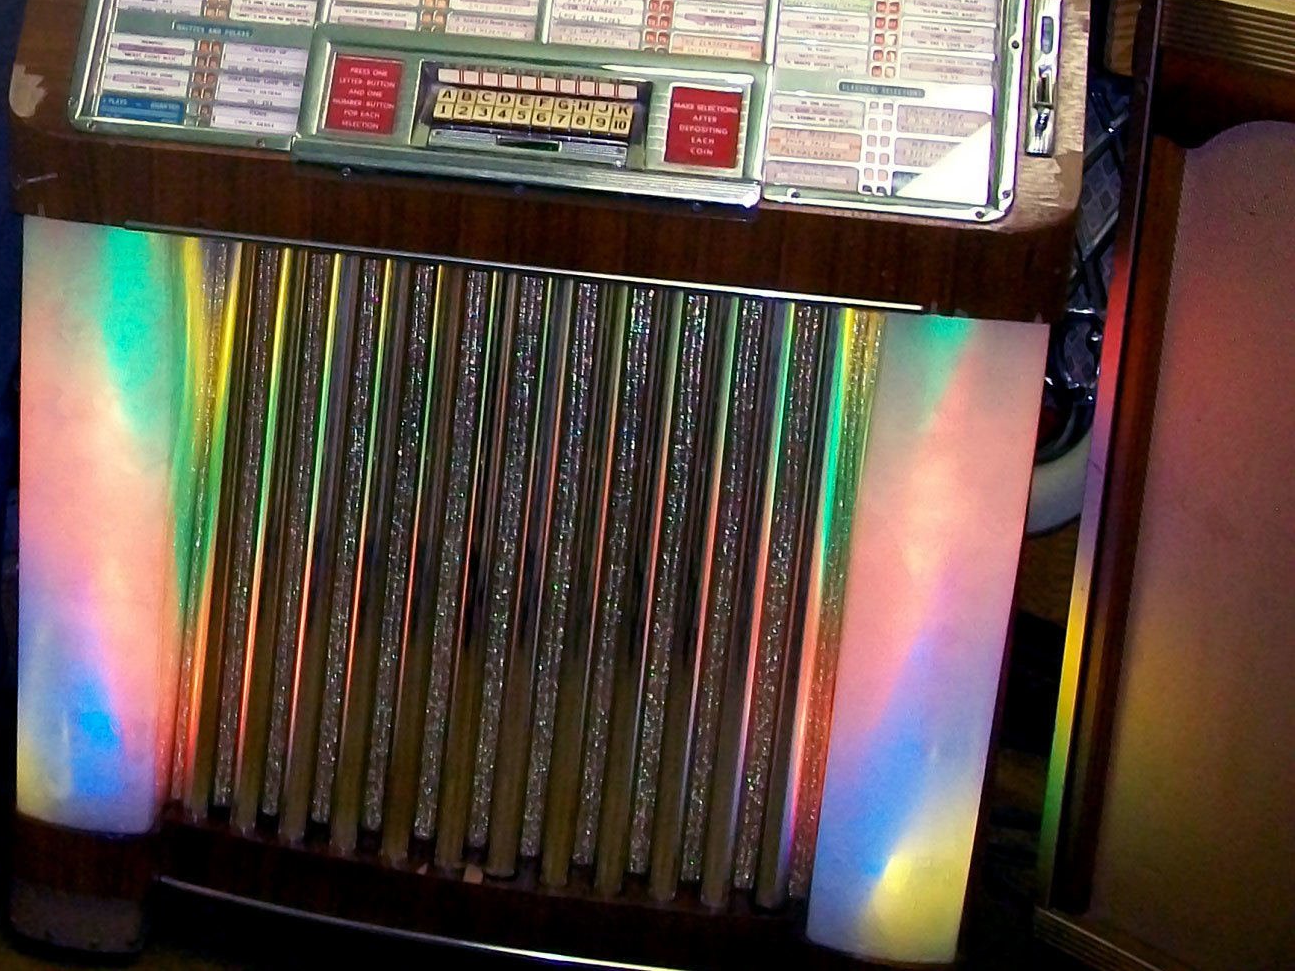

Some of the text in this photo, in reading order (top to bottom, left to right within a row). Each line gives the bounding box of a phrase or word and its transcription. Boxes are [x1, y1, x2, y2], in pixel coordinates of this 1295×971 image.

[350, 67, 388, 78] PRESS ONE
[339, 77, 396, 89] LETTER BUTTON
[348, 88, 383, 98] AND ONE
[332, 98, 396, 109] NUMBER BUTTON
[442, 90, 628, 115] A B C D E F G H J K
[673, 102, 739, 114] MAKE SELECTIONS
[343, 109, 380, 119] FOR EACH
[441, 104, 627, 130] 1 2 3 4 5 6 7 8 9 10
[692, 114, 717, 123] AFTER
[341, 119, 380, 129] SELECTION
[679, 124, 728, 135] DEPOSITING
[691, 136, 715, 144] EACH
[689, 147, 713, 156] COIN
